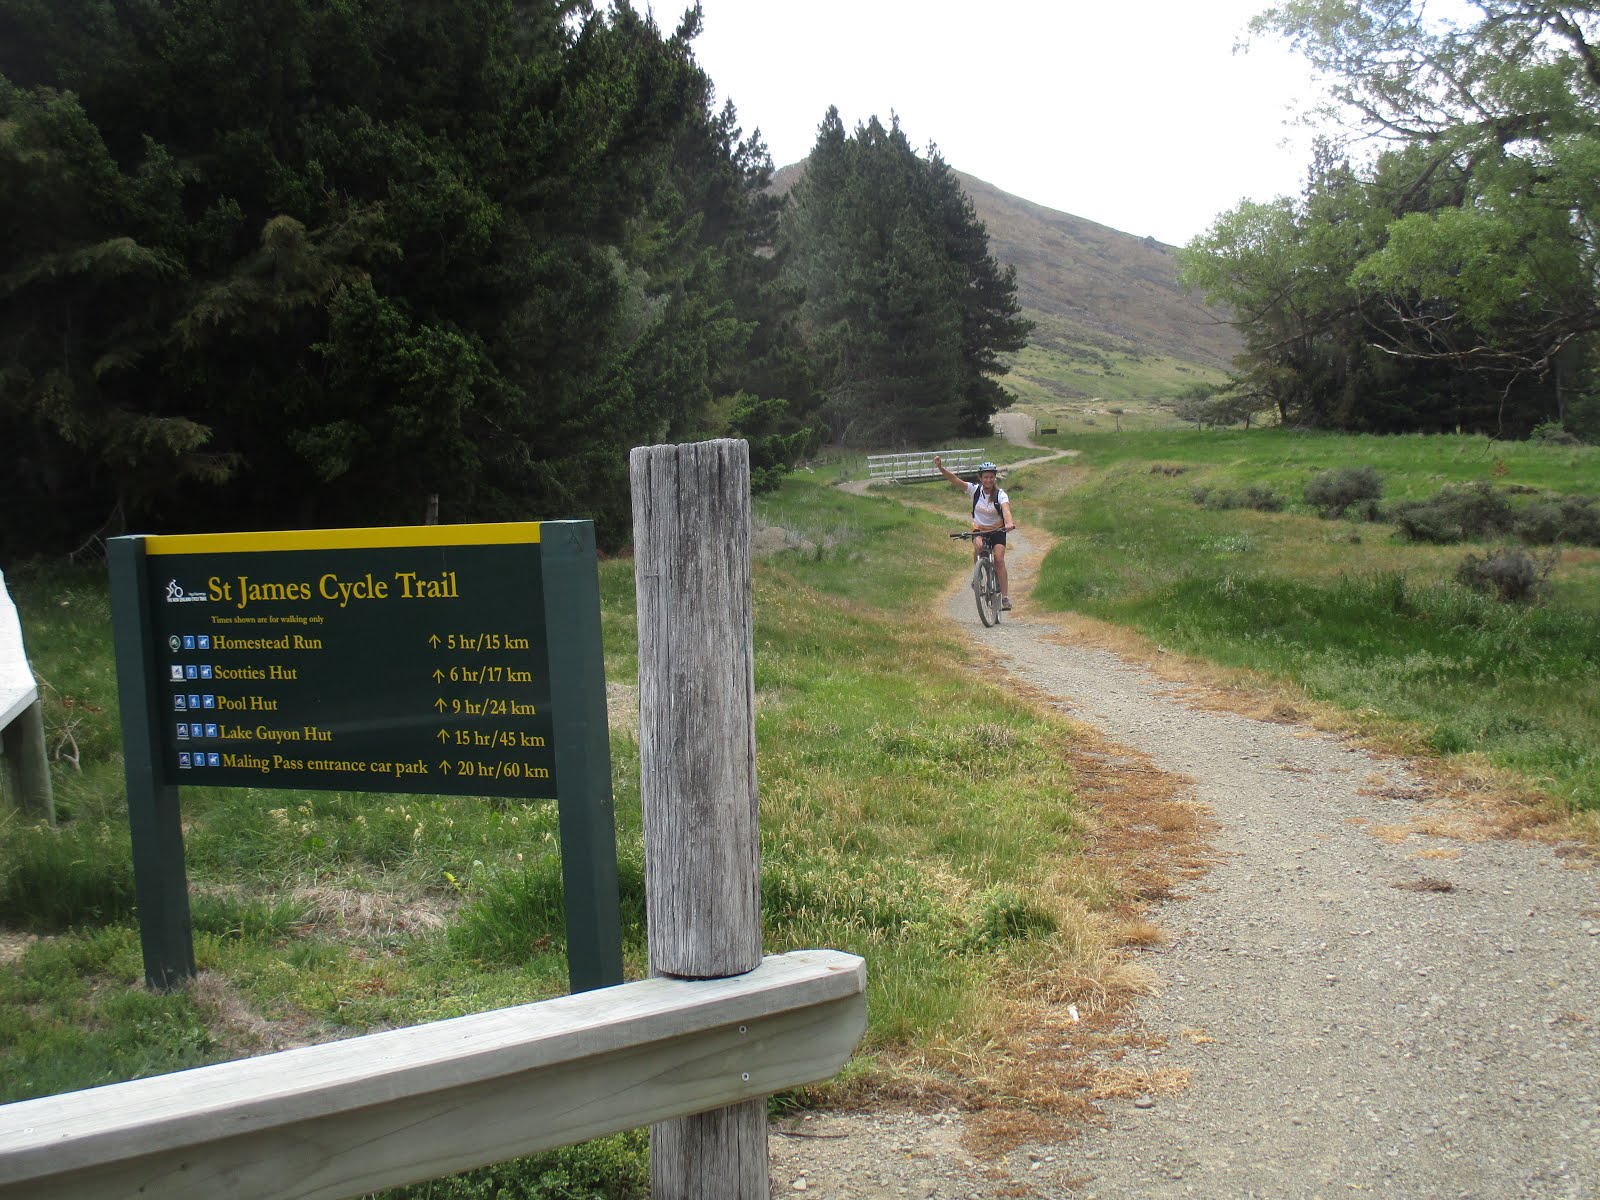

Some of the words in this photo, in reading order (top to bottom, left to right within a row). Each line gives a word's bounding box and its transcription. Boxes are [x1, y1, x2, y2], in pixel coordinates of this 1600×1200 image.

[208, 576, 232, 602] St
[237, 575, 312, 609] James
[319, 573, 389, 608] Cycle
[395, 571, 460, 599] Trail
[211, 615, 233, 624] Times
[234, 615, 256, 624] shown
[269, 615, 279, 624] for
[280, 615, 308, 625] walking
[309, 615, 324, 625] only
[212, 635, 289, 650] Homestead
[293, 635, 322, 649] Run
[447, 634, 456, 649] 5
[460, 633, 501, 651] hr/15
[504, 634, 529, 649] km
[214, 665, 266, 680] Scotties
[269, 665, 297, 680] Hut
[450, 666, 459, 682] 6
[463, 665, 502, 684] hr/17
[506, 666, 532, 682] km
[217, 695, 247, 710] Pool
[250, 696, 278, 711] Hut
[452, 699, 461, 714] 9
[465, 698, 507, 716] hr/24
[511, 700, 536, 715] km
[219, 725, 252, 740] Lake
[255, 726, 301, 744] Guyon
[303, 726, 332, 742] Hut
[454, 730, 470, 745] 15
[474, 730, 516, 748] hr/45
[520, 732, 546, 747] km
[222, 753, 270, 774] Maling
[272, 755, 304, 770] Pass
[307, 760, 367, 772] entrance
[370, 761, 391, 773] car
[395, 759, 429, 778] park
[457, 760, 474, 776] 20
[478, 761, 520, 779] hr/60
[524, 763, 550, 778] km
